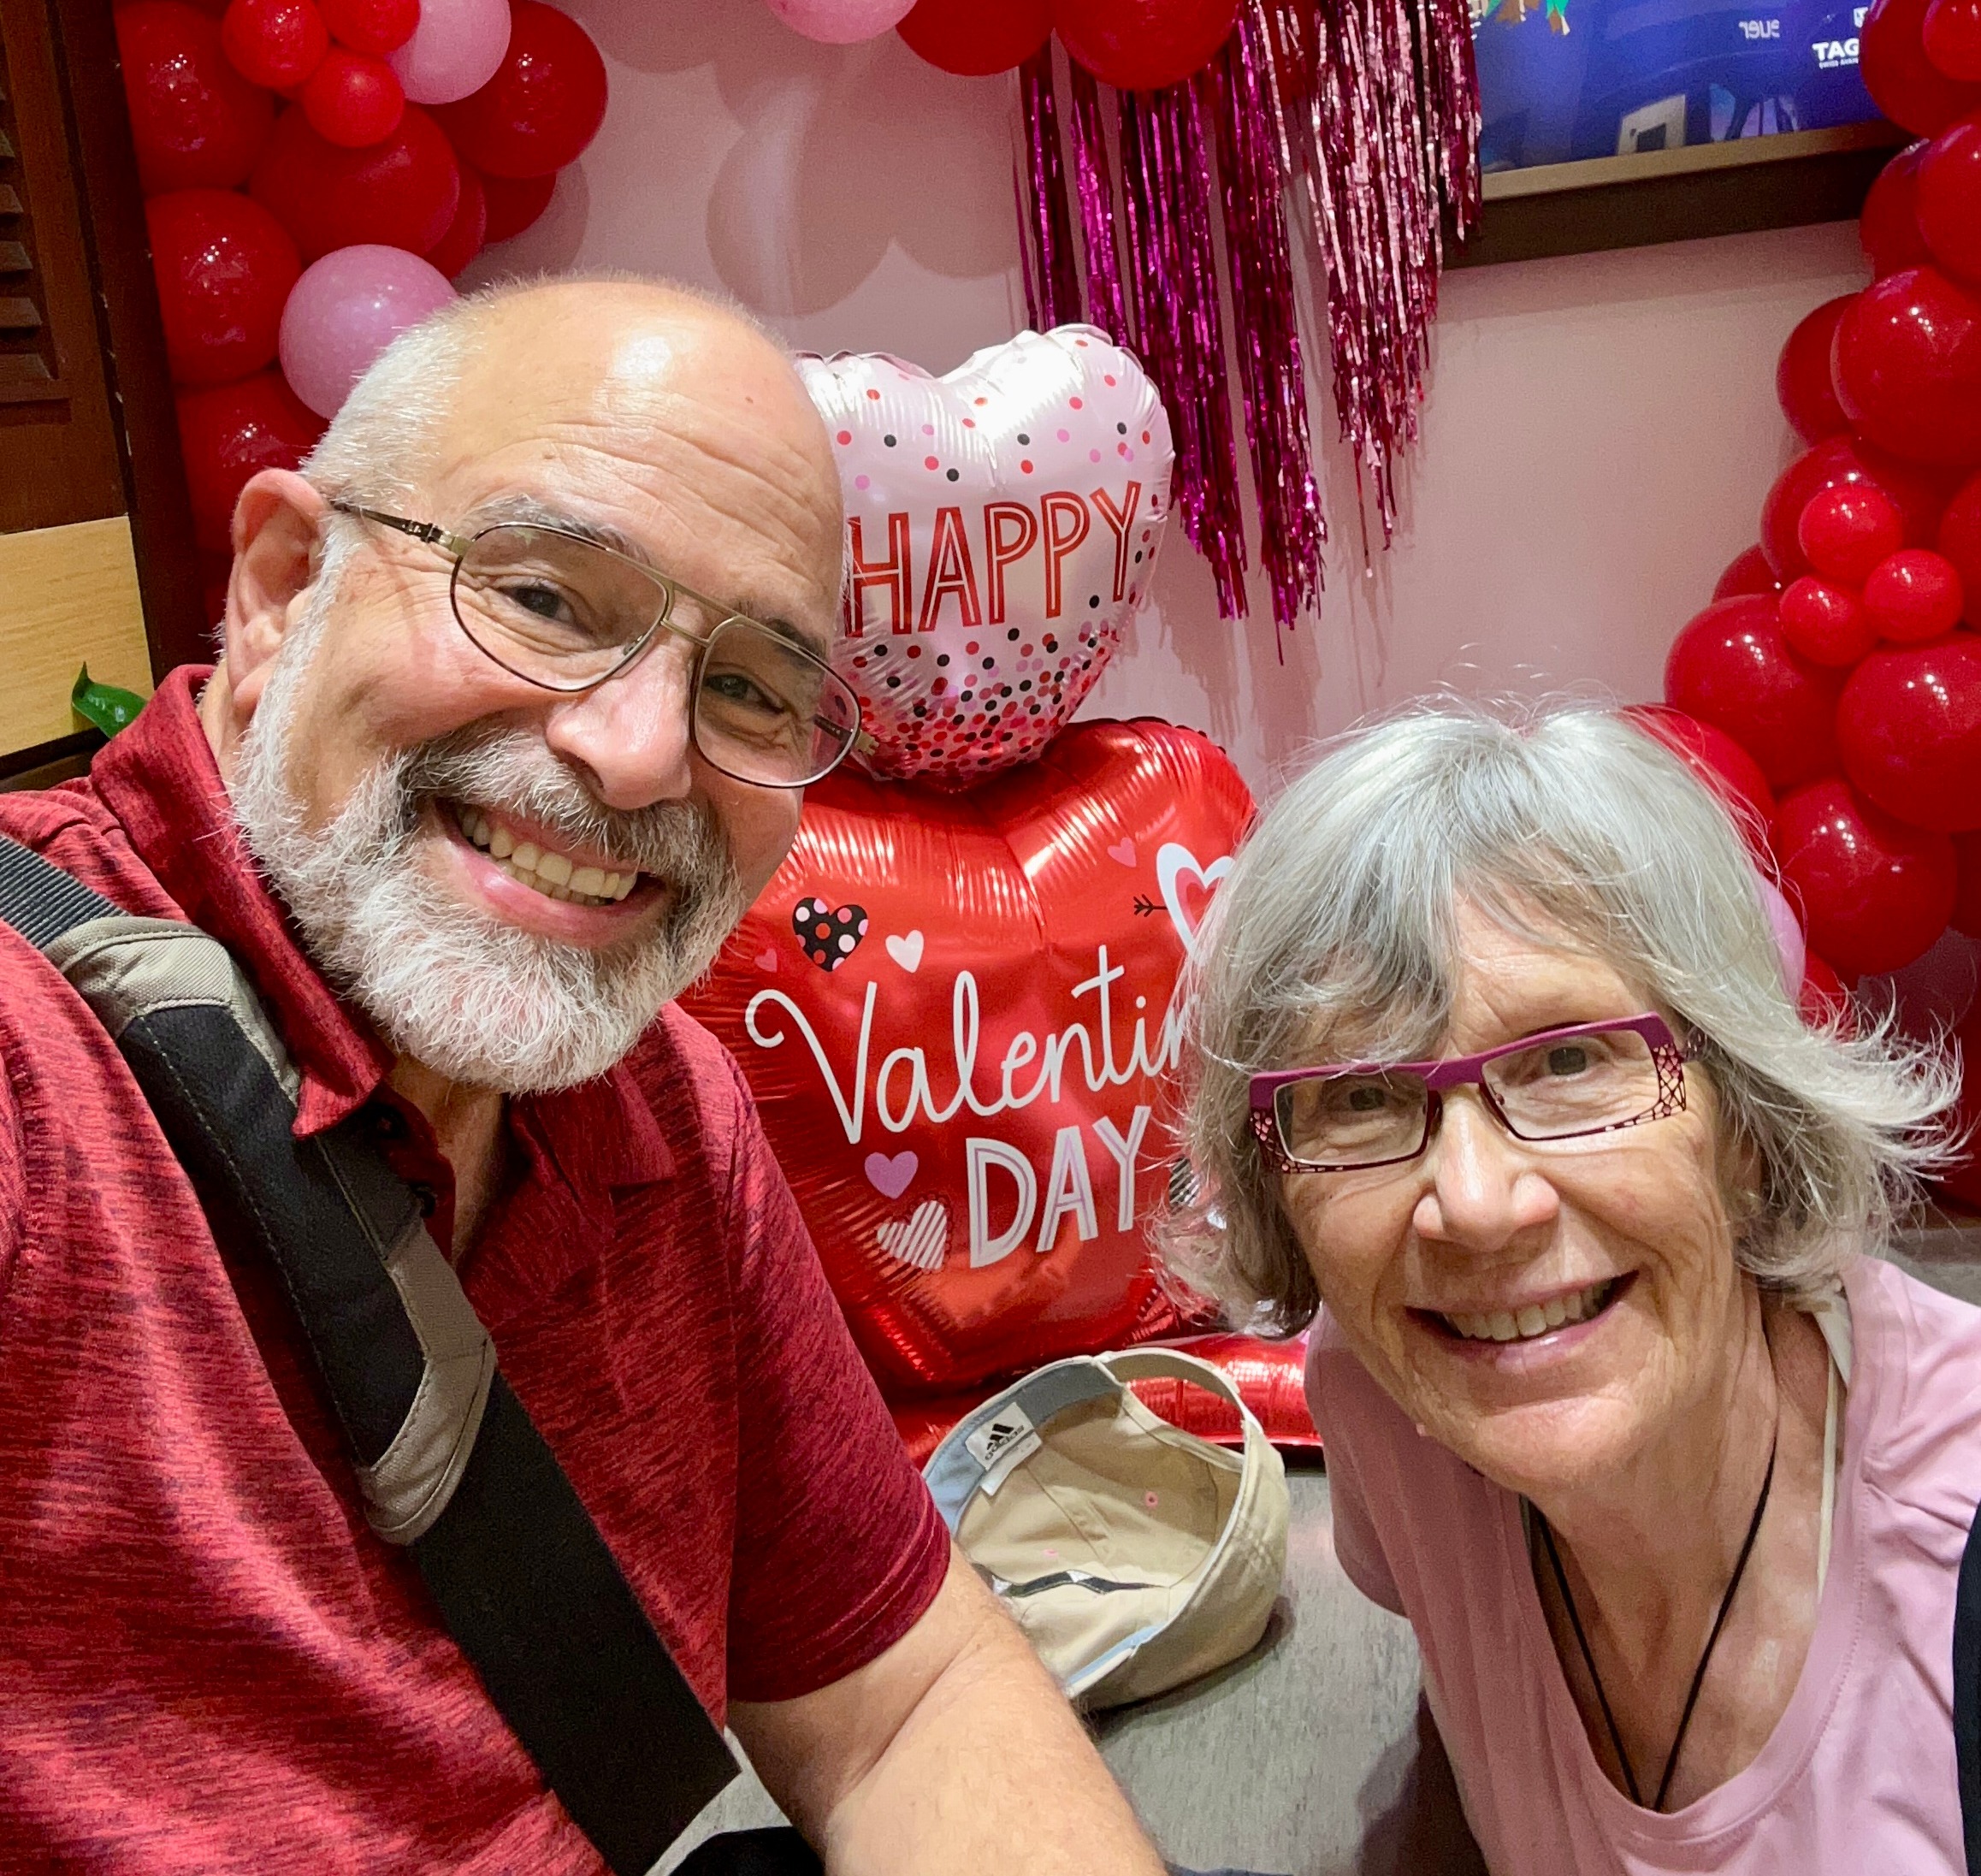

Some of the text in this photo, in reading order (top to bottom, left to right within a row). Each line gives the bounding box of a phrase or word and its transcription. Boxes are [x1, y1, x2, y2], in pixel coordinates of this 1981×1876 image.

[1812, 38, 1860, 62] TAG
[844, 481, 1142, 638] HAPPY
[966, 1105, 1151, 1269] DAY
[985, 1424, 1025, 1460] adidas
